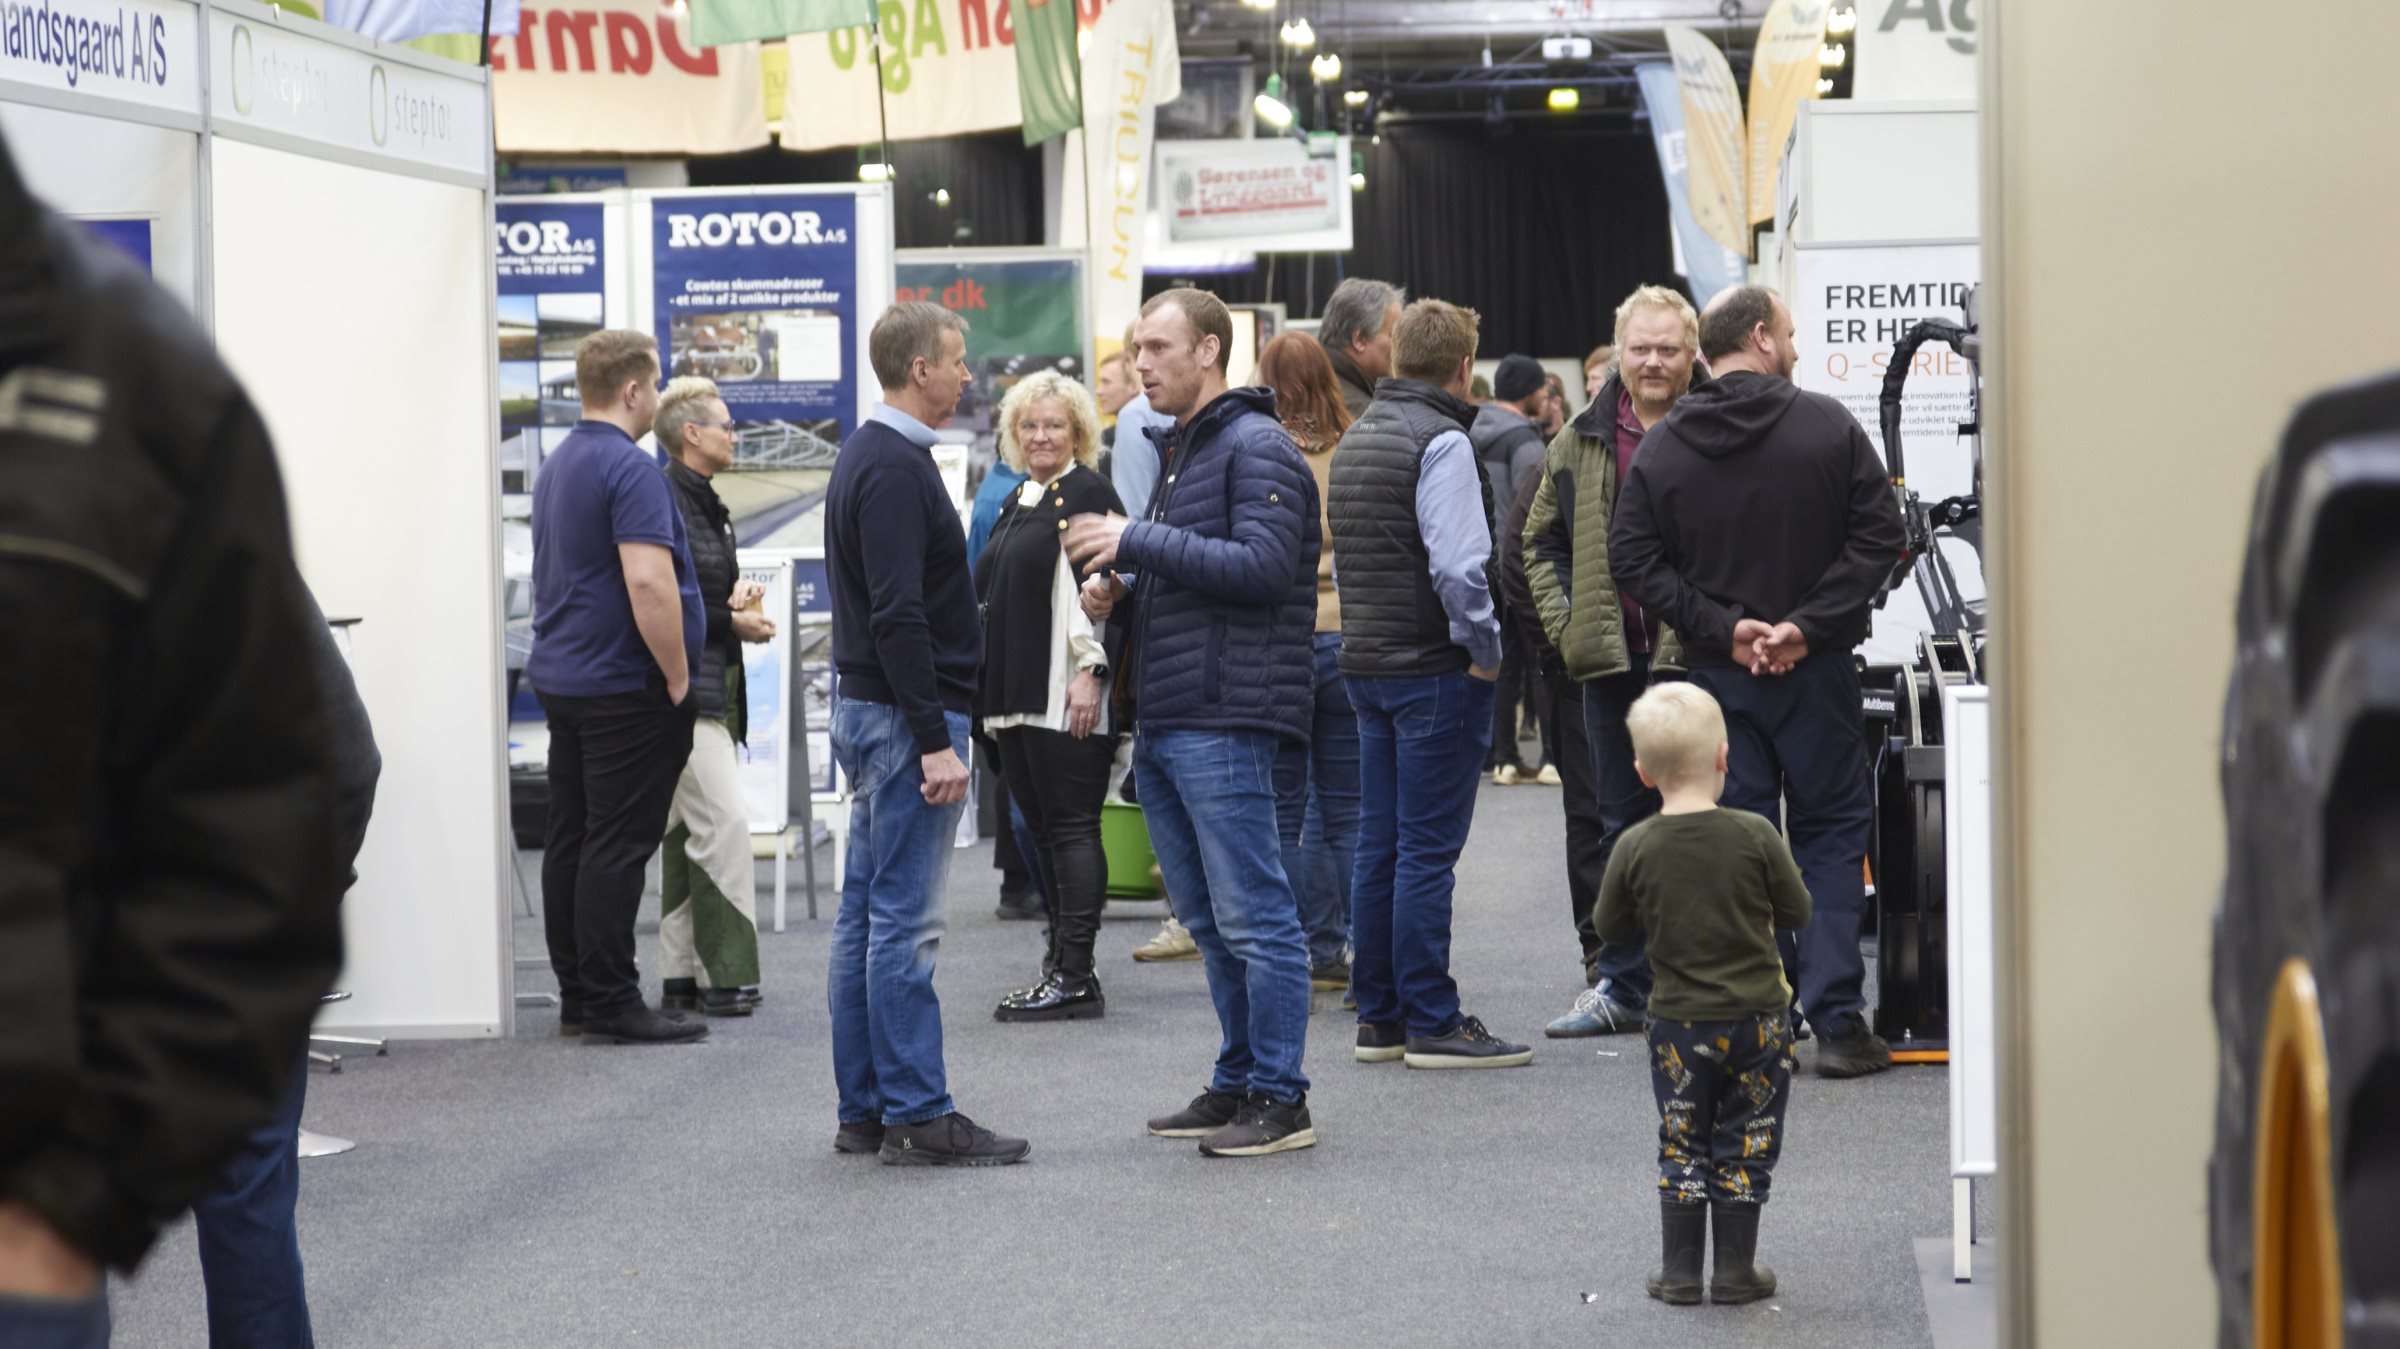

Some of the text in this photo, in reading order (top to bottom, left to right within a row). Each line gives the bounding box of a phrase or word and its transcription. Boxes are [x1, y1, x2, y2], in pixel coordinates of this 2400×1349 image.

[0, 0, 167, 88] andsgaard A/S
[668, 211, 823, 247] ROTOR
[685, 277, 824, 292] Cowtex skummadrasser
[676, 294, 689, 306] et
[691, 293, 714, 305] mix
[729, 292, 738, 304] 2
[739, 292, 779, 303] unikke
[781, 291, 840, 306] produkter
[1826, 283, 1982, 310] FREMTID
[1827, 317, 1926, 343] ER HE
[1827, 351, 1975, 381] Q-SRIE
[1910, 390, 1957, 400] innovation
[1905, 403, 1920, 412] der
[1922, 403, 1933, 412] vil
[1934, 404, 1962, 412] sætte
[1908, 416, 1945, 425] udviklet
[742, 573, 776, 583] ator
